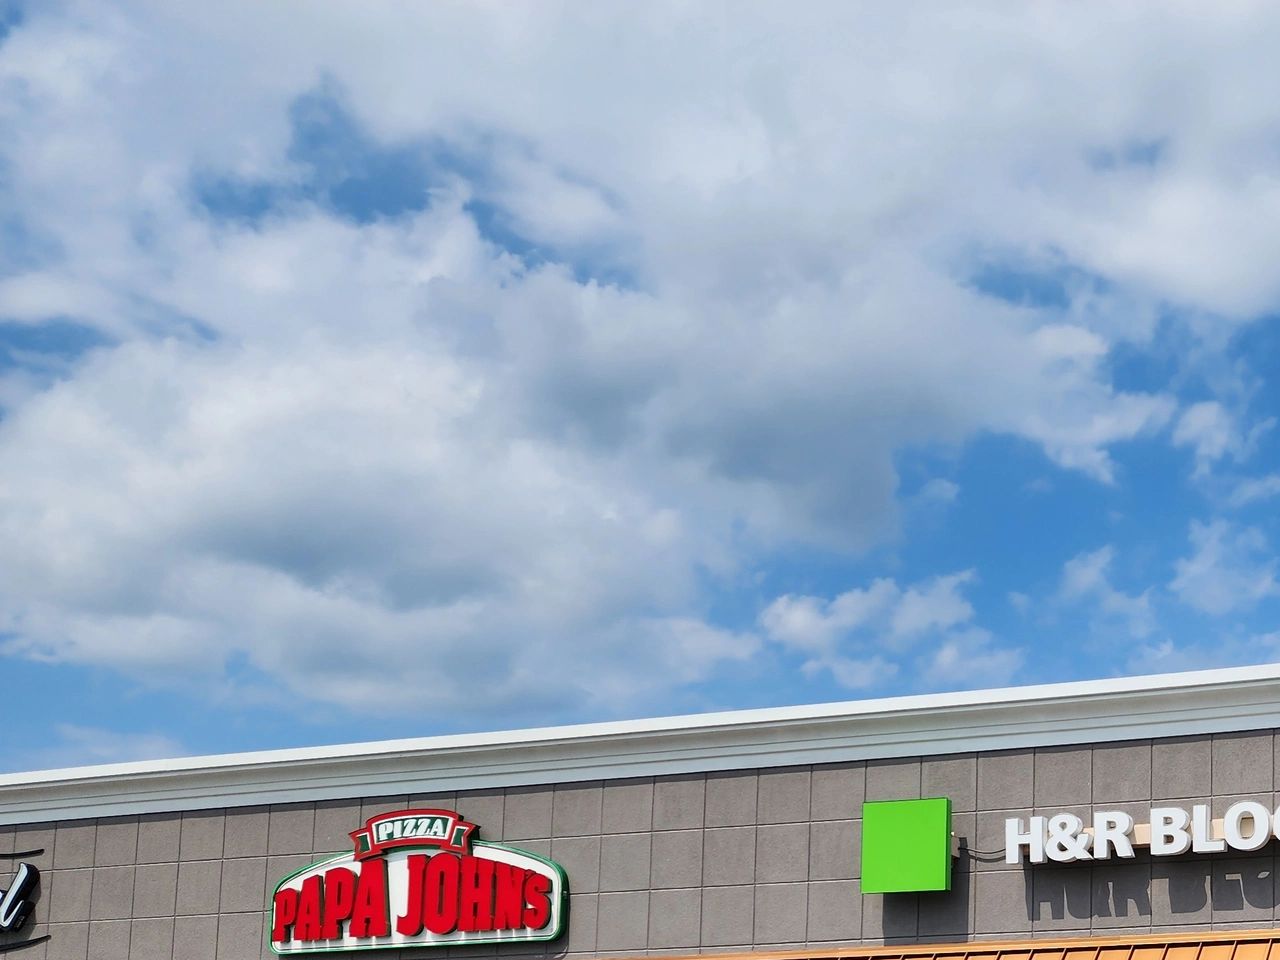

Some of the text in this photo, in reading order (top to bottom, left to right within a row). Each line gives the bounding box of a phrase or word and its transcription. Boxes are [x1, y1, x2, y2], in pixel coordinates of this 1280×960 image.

[377, 818, 445, 841] PIZZA
[1005, 812, 1135, 864] H&R
[272, 858, 391, 943] PAPA
